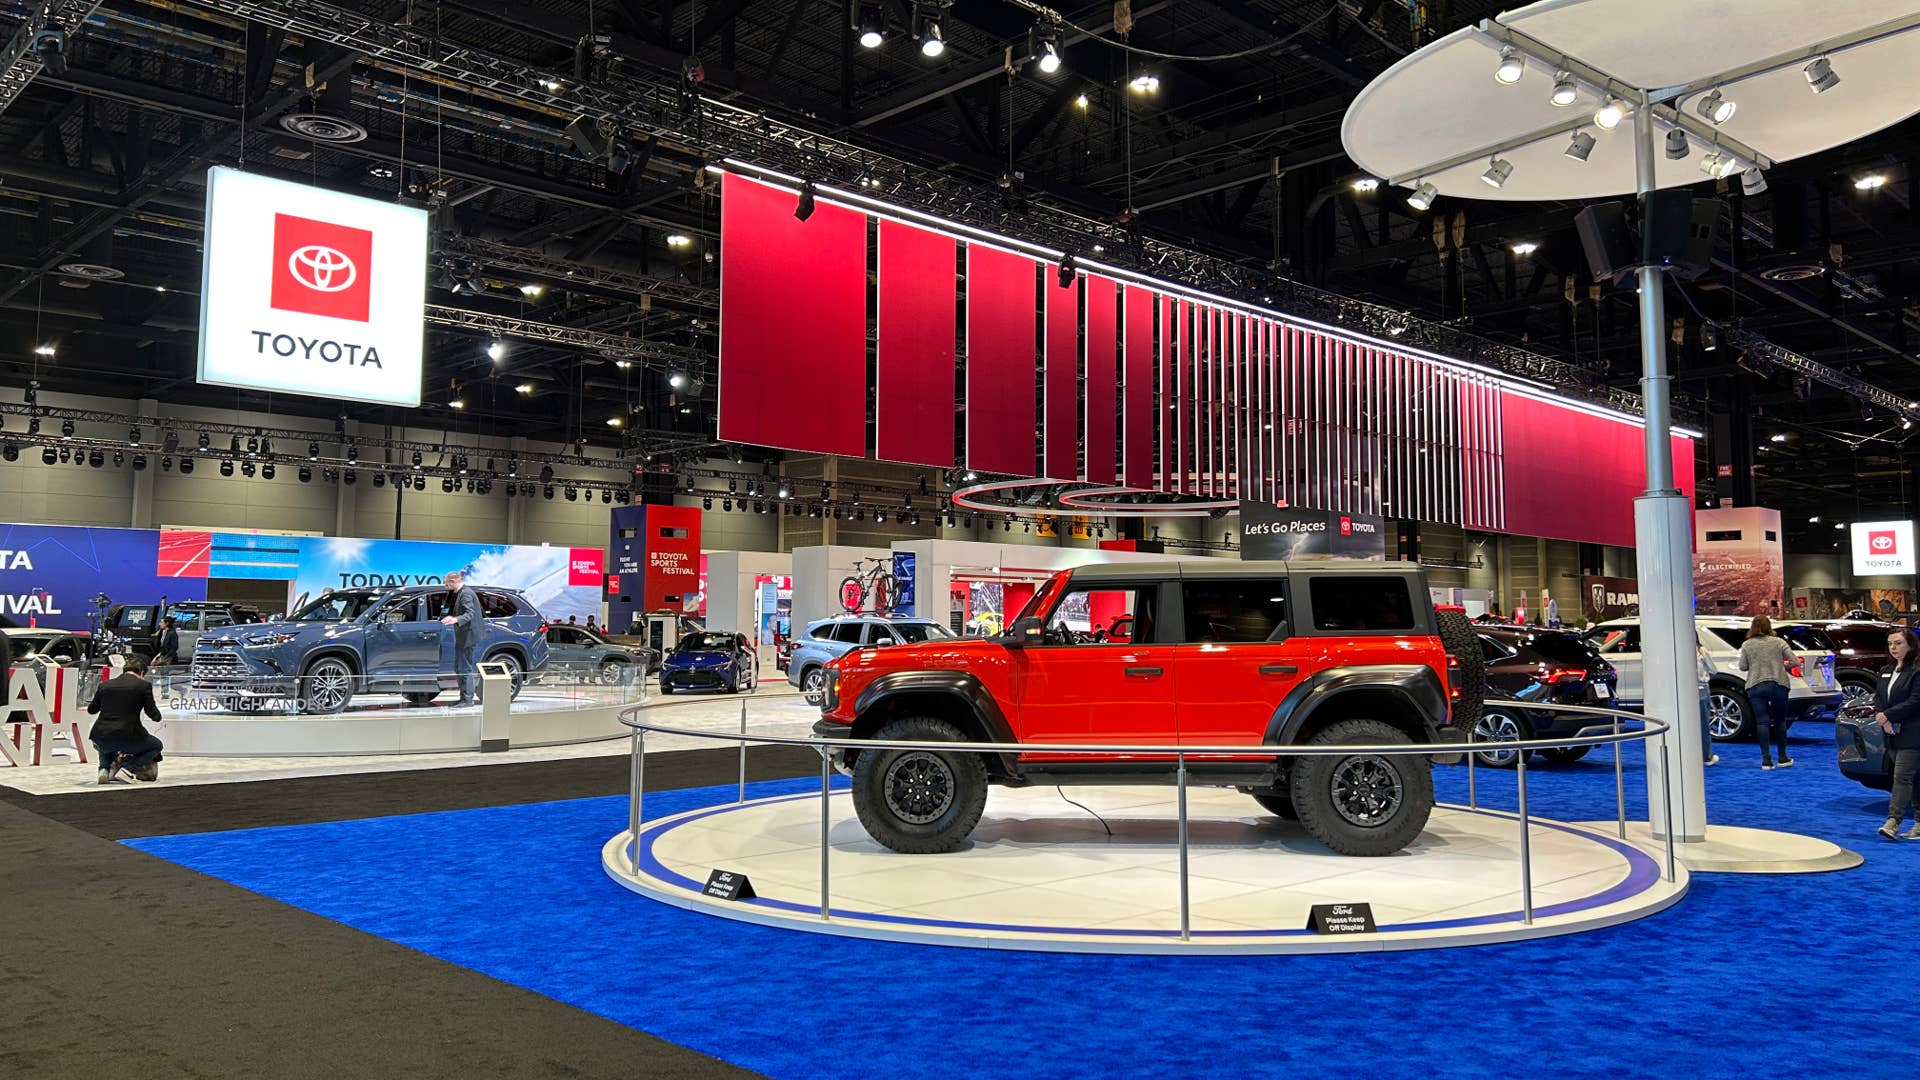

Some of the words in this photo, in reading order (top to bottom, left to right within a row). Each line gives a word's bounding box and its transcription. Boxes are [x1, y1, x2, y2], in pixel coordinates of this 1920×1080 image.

[251, 330, 383, 369] TOYOTA
[1245, 523, 1269, 535] Let's
[1270, 522, 1287, 533] Go
[1289, 520, 1326, 532] Places
[1352, 522, 1375, 533] TOYOTA
[658, 552, 688, 561] TOYOTA
[662, 567, 695, 575] FESTIVAL
[339, 573, 410, 588] TODAY
[1606, 592, 1639, 606] RAM
[169, 697, 220, 711] GRAND
[1332, 905, 1353, 915] Ford
[1347, 916, 1365, 924] Keep
[1329, 924, 1340, 932] Off
[1340, 924, 1364, 932] Display
